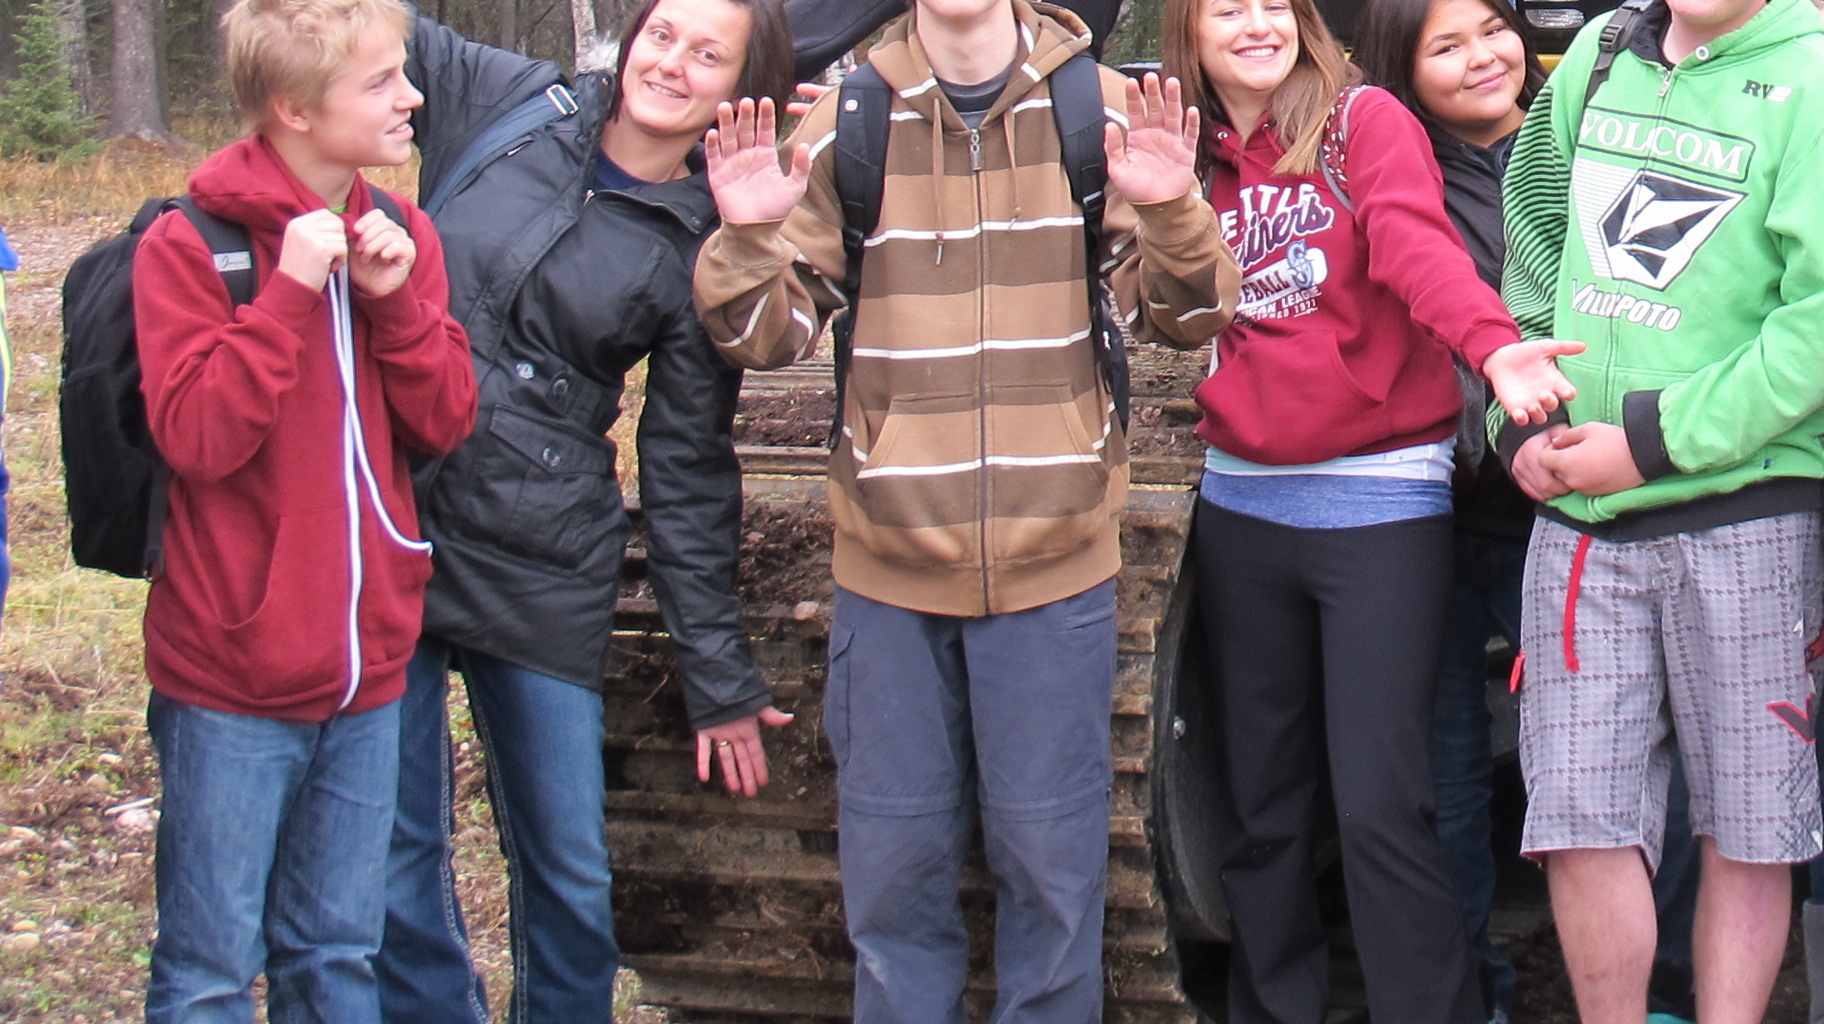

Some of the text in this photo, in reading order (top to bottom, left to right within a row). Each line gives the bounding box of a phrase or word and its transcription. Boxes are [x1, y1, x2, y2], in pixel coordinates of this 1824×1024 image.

[1578, 111, 1746, 177] VOLCOM
[1232, 193, 1335, 270] iners
[1240, 270, 1291, 305] EBALL
